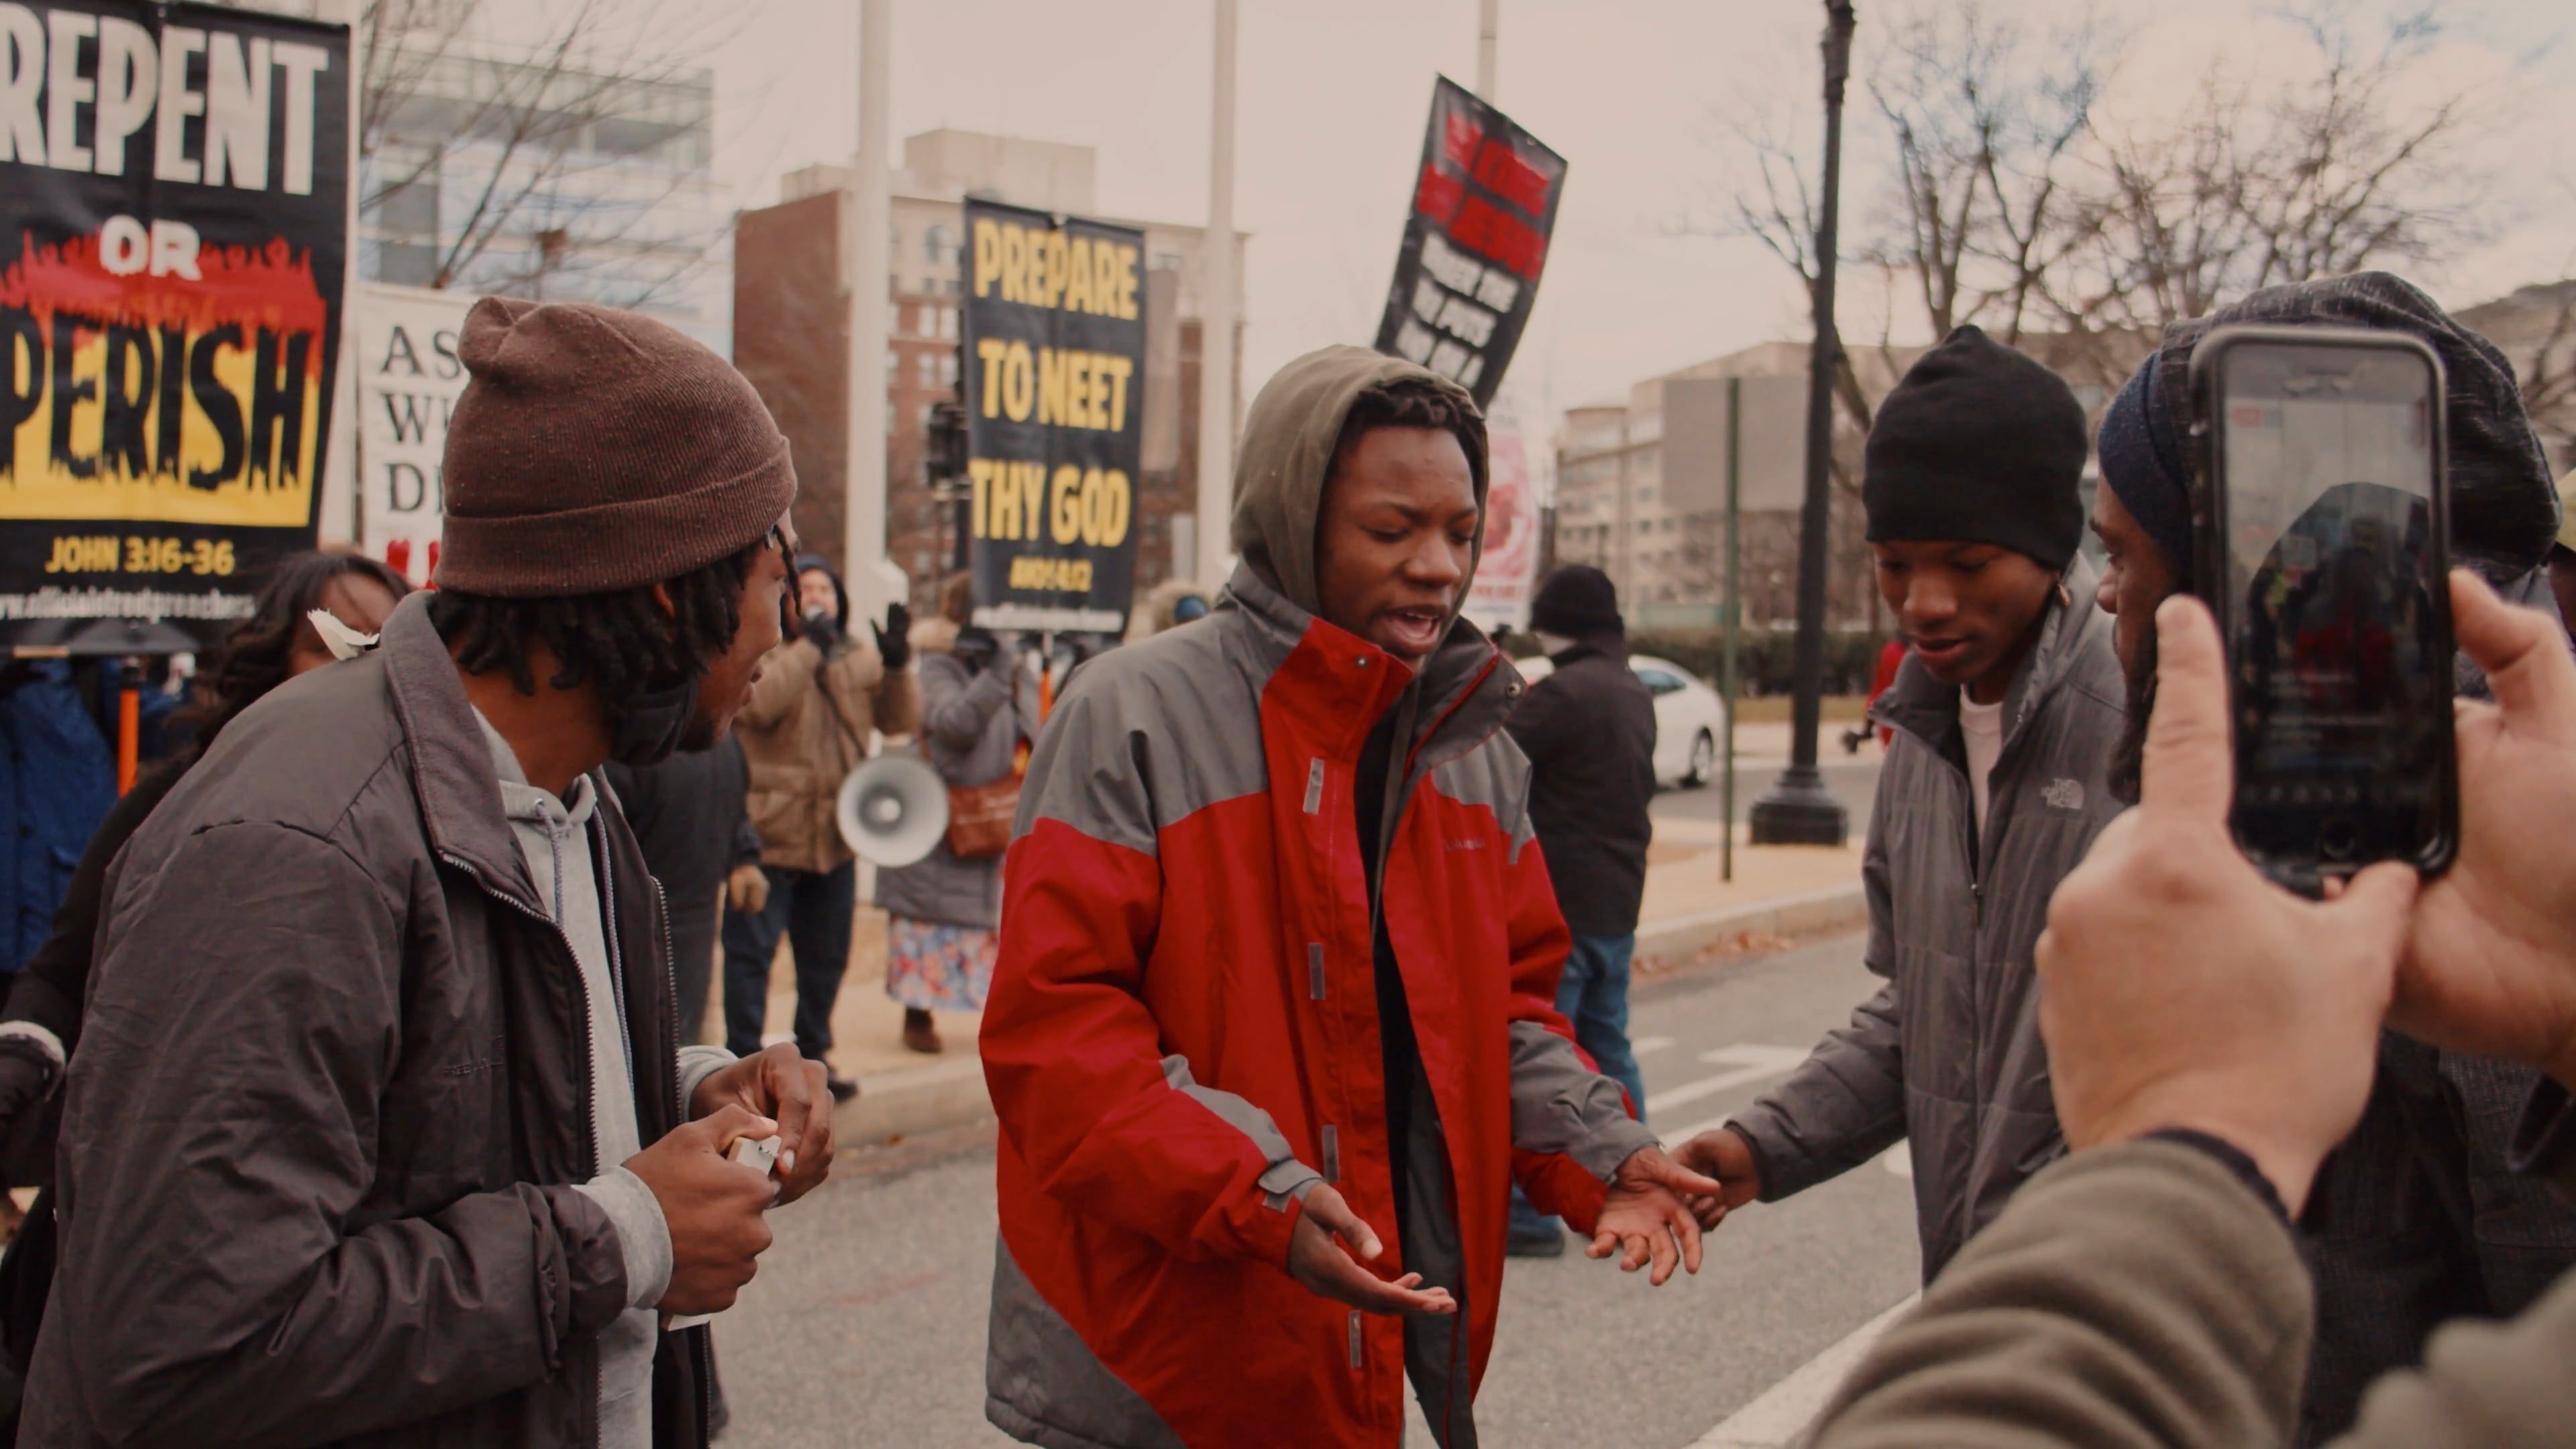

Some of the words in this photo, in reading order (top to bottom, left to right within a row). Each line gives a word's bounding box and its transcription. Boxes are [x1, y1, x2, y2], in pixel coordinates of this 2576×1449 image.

[0, 2, 328, 195] REPENT
[99, 215, 201, 281] OR
[973, 217, 1140, 321] PREPARE
[0, 312, 313, 491] PERISH
[977, 337, 1034, 423] TO
[968, 459, 1047, 543] THY
[1050, 464, 1132, 549] GOD
[45, 535, 120, 574] JOHN
[124, 535, 235, 577] 3:16-36
